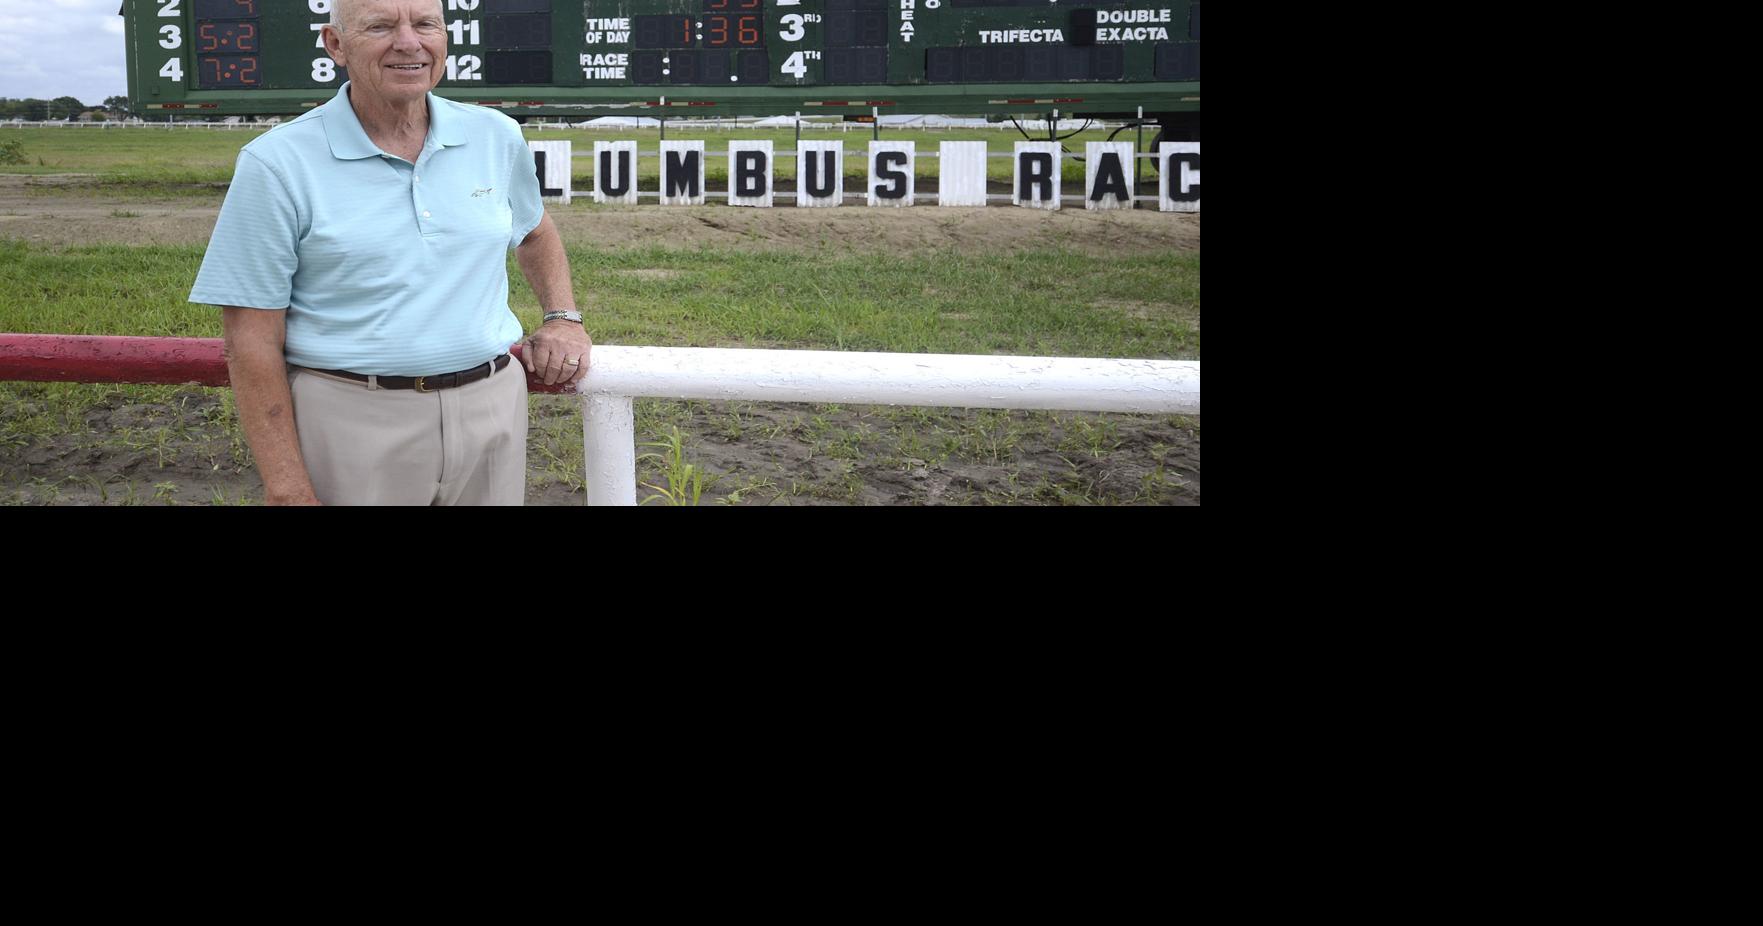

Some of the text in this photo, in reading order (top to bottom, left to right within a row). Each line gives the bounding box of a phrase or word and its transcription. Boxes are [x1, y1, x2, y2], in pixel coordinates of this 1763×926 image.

[157, 0, 181, 17] 2
[1096, 9, 1171, 23] DOUBLE
[586, 18, 631, 30] TIME
[900, 0, 915, 42] HEAT
[158, 24, 182, 49] 3
[447, 20, 480, 45] 11
[586, 31, 631, 44] OF DAY
[684, 16, 758, 44] 1:36
[979, 29, 1064, 43] TRIFECTA
[1096, 27, 1169, 41] EXACTA
[445, 55, 482, 81] 12
[580, 53, 629, 66] RACE
[159, 57, 183, 82] 4
[311, 57, 336, 83] 8
[583, 67, 626, 79] TIME
